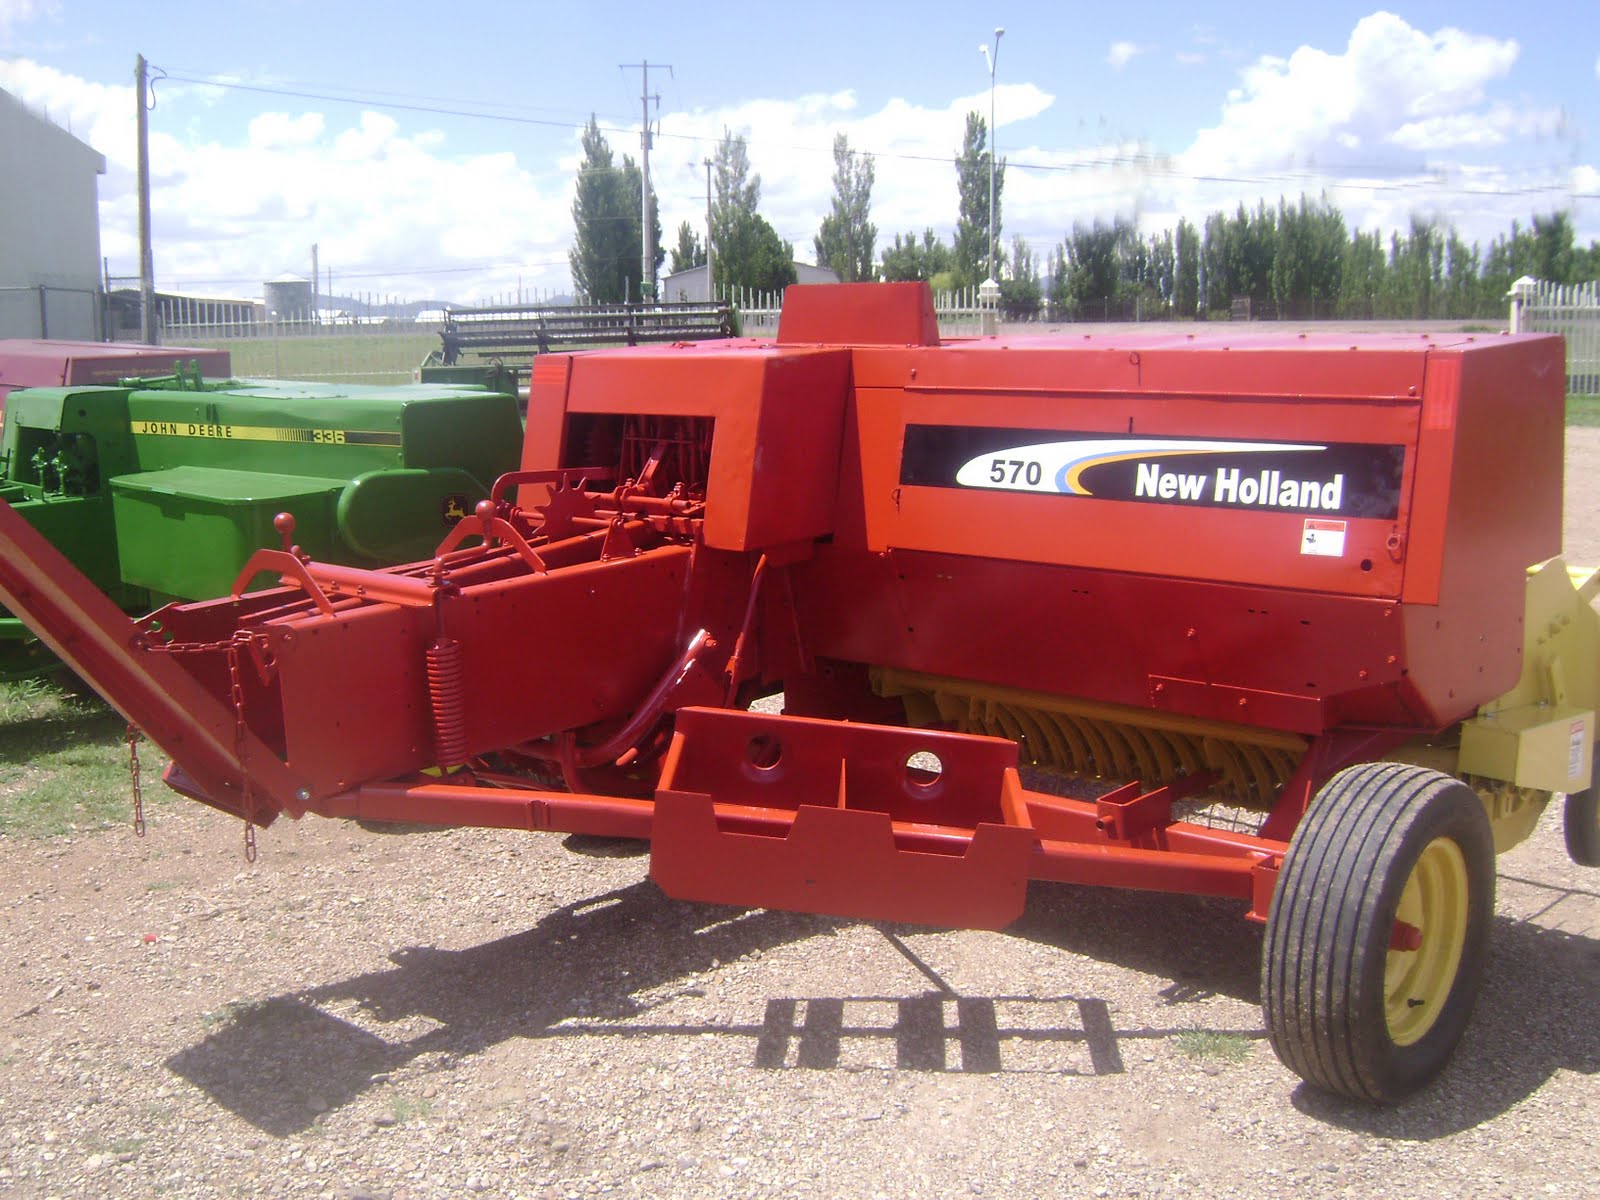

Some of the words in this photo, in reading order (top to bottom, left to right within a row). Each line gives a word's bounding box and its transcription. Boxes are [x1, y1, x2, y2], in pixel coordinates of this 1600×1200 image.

[142, 422, 177, 435] JOHN
[188, 424, 232, 438] DEERE
[312, 429, 345, 444] 336
[990, 459, 1042, 486] 570
[1135, 463, 1206, 500] New
[1213, 468, 1343, 510] Holland
